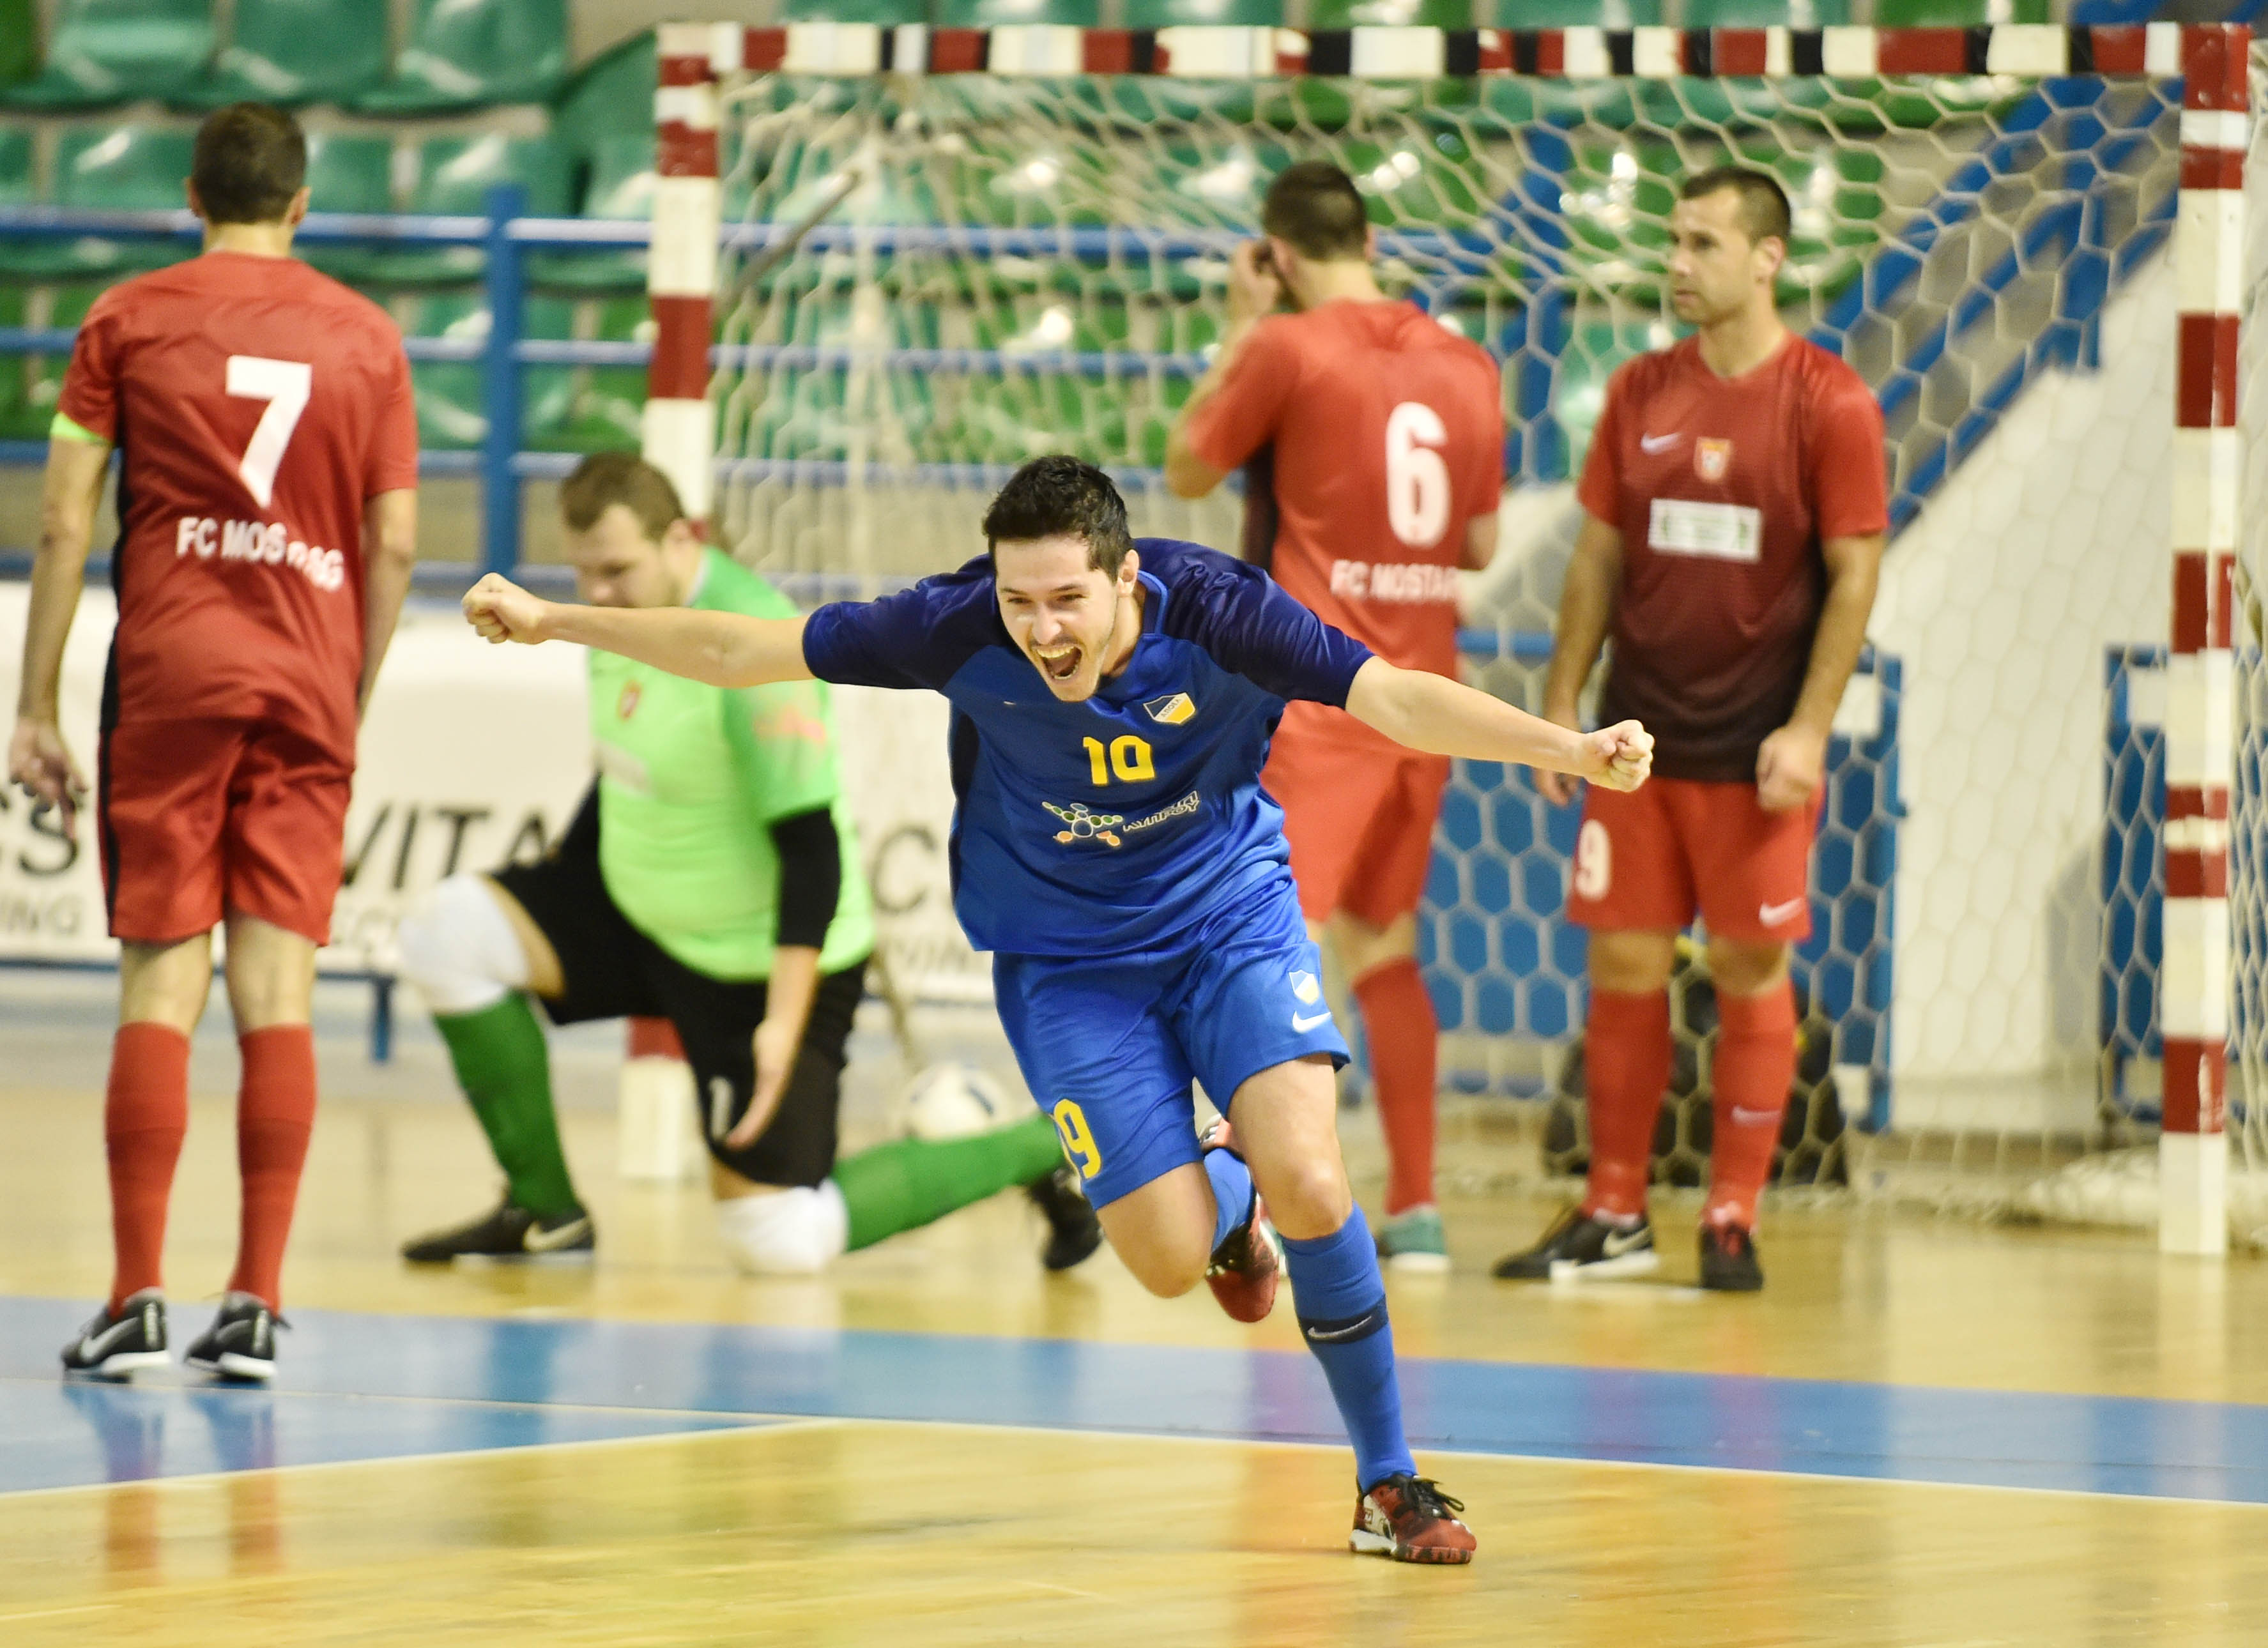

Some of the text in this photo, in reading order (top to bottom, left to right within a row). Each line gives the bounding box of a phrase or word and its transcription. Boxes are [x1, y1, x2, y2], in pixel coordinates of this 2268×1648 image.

[226, 355, 312, 508] 7
[1384, 401, 1453, 549] 6
[176, 517, 217, 559] FC
[1575, 818, 1612, 903] 9
